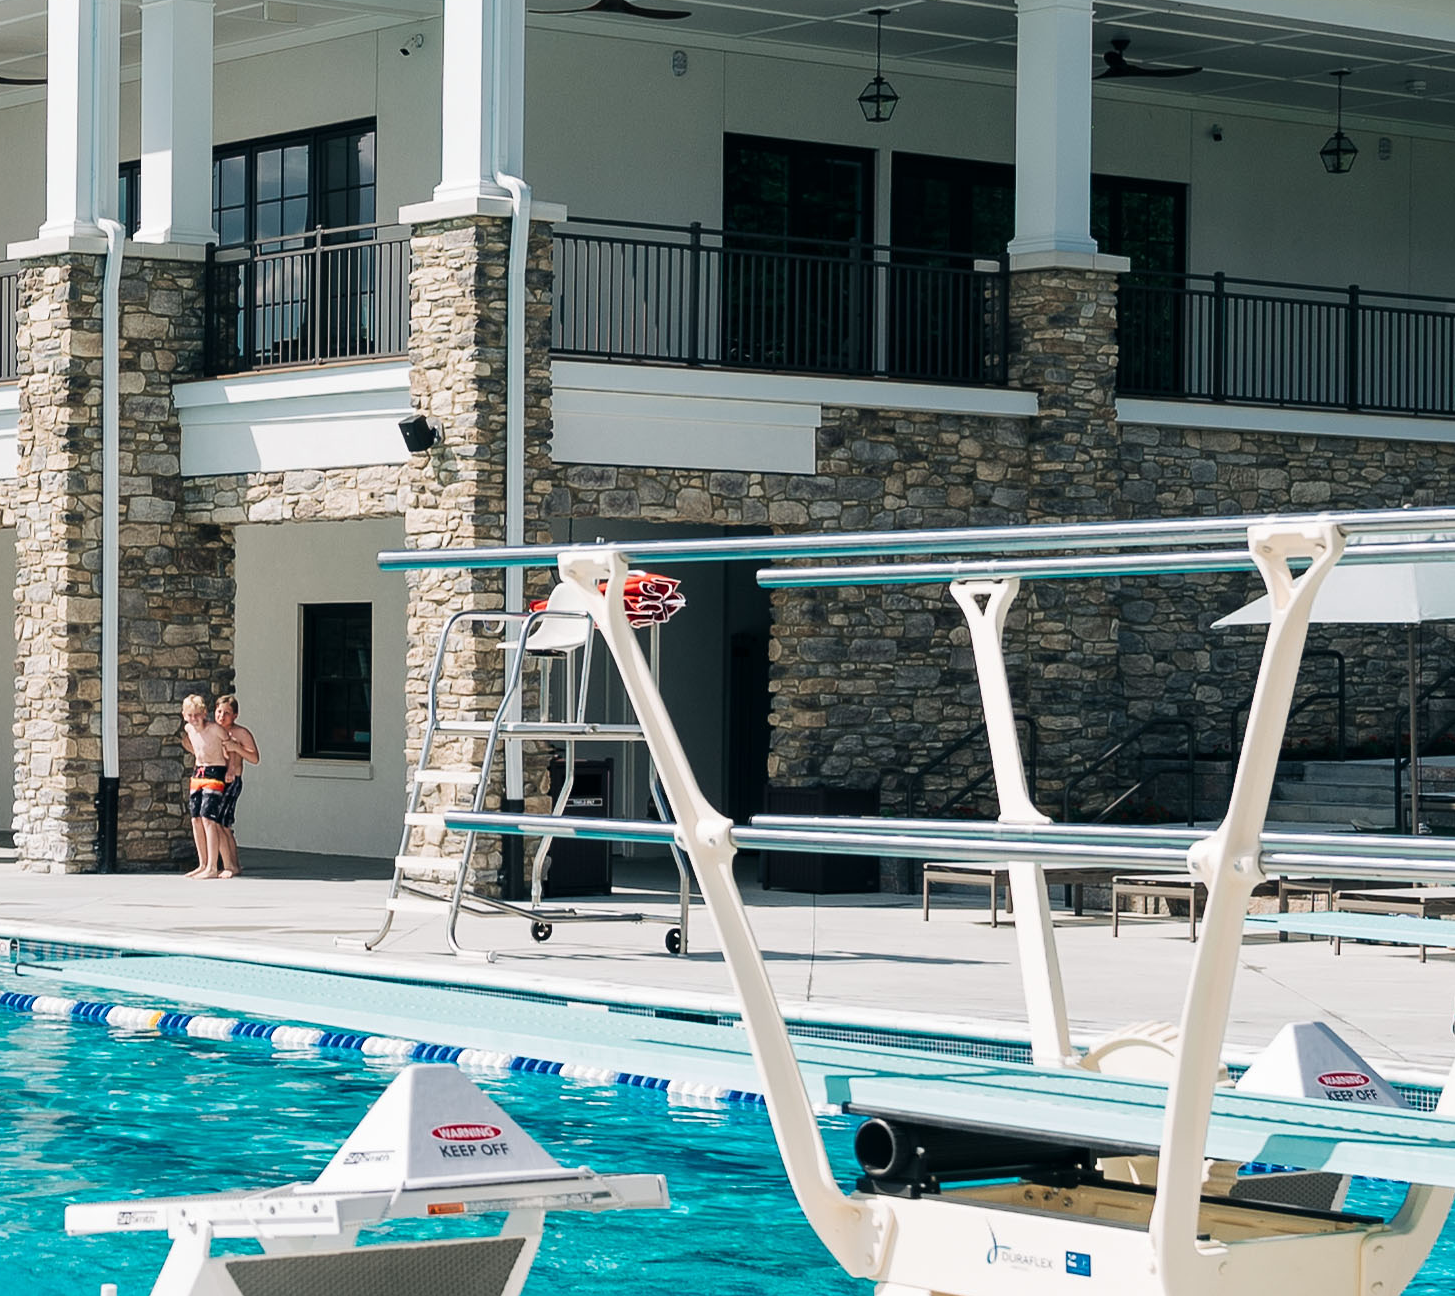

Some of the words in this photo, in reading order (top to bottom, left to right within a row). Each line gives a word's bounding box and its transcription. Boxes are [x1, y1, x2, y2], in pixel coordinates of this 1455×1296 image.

[1321, 1075, 1365, 1085] WARNING
[1325, 1090, 1353, 1101] KEEP
[1356, 1089, 1377, 1100] OFF
[438, 1126, 495, 1139] WARNING
[439, 1144, 476, 1158] KEEP
[481, 1143, 509, 1156] OFF
[1001, 1251, 1054, 1269] DURAFLEX
